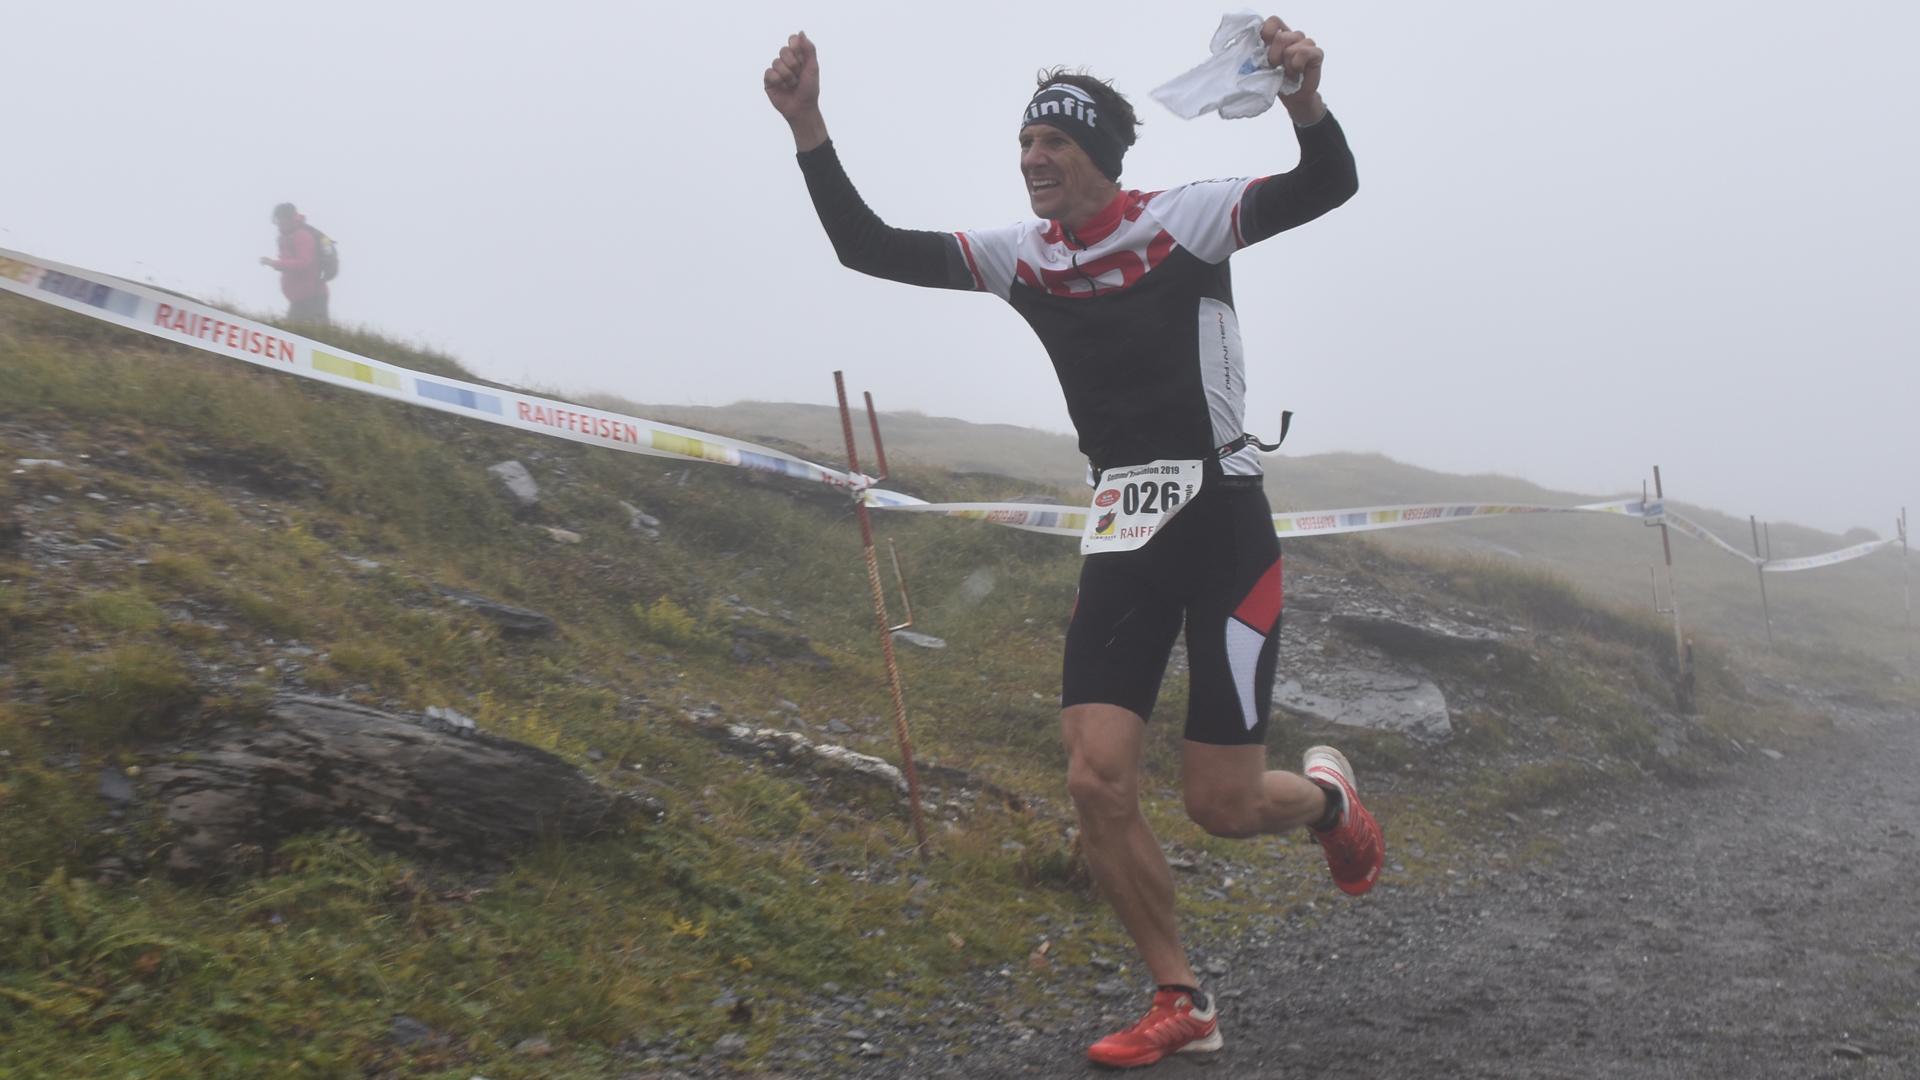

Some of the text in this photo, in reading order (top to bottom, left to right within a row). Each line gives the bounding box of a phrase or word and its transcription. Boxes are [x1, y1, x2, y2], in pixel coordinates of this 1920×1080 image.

[153, 302, 295, 364] RAIFFEISEN
[516, 400, 639, 445] RAIFFEISEN
[1160, 465, 1180, 475] 2019
[1123, 481, 1181, 516] 026
